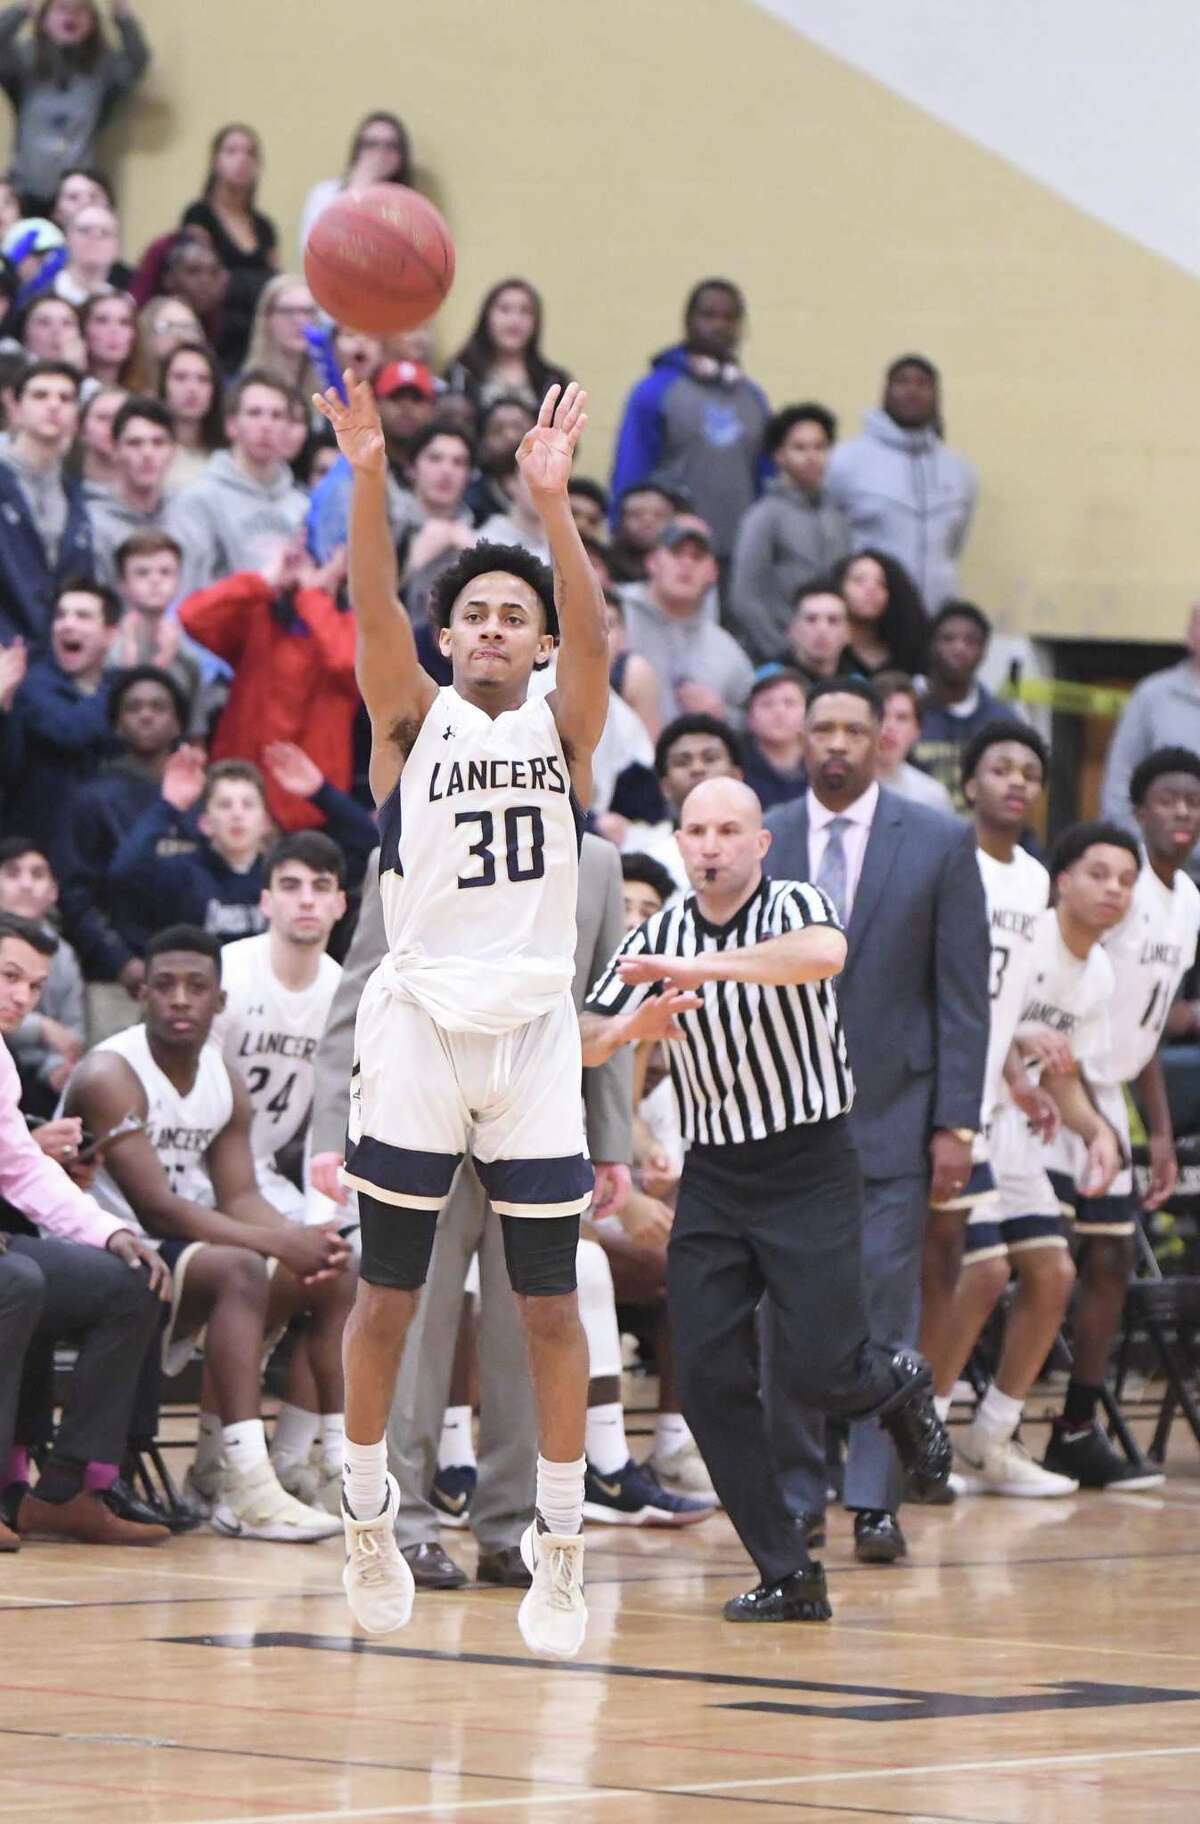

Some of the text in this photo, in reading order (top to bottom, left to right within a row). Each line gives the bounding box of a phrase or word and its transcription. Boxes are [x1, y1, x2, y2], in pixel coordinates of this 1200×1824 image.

[429, 756, 566, 802] LANCERS
[454, 805, 545, 889] 30
[247, 1065, 298, 1124] 24
